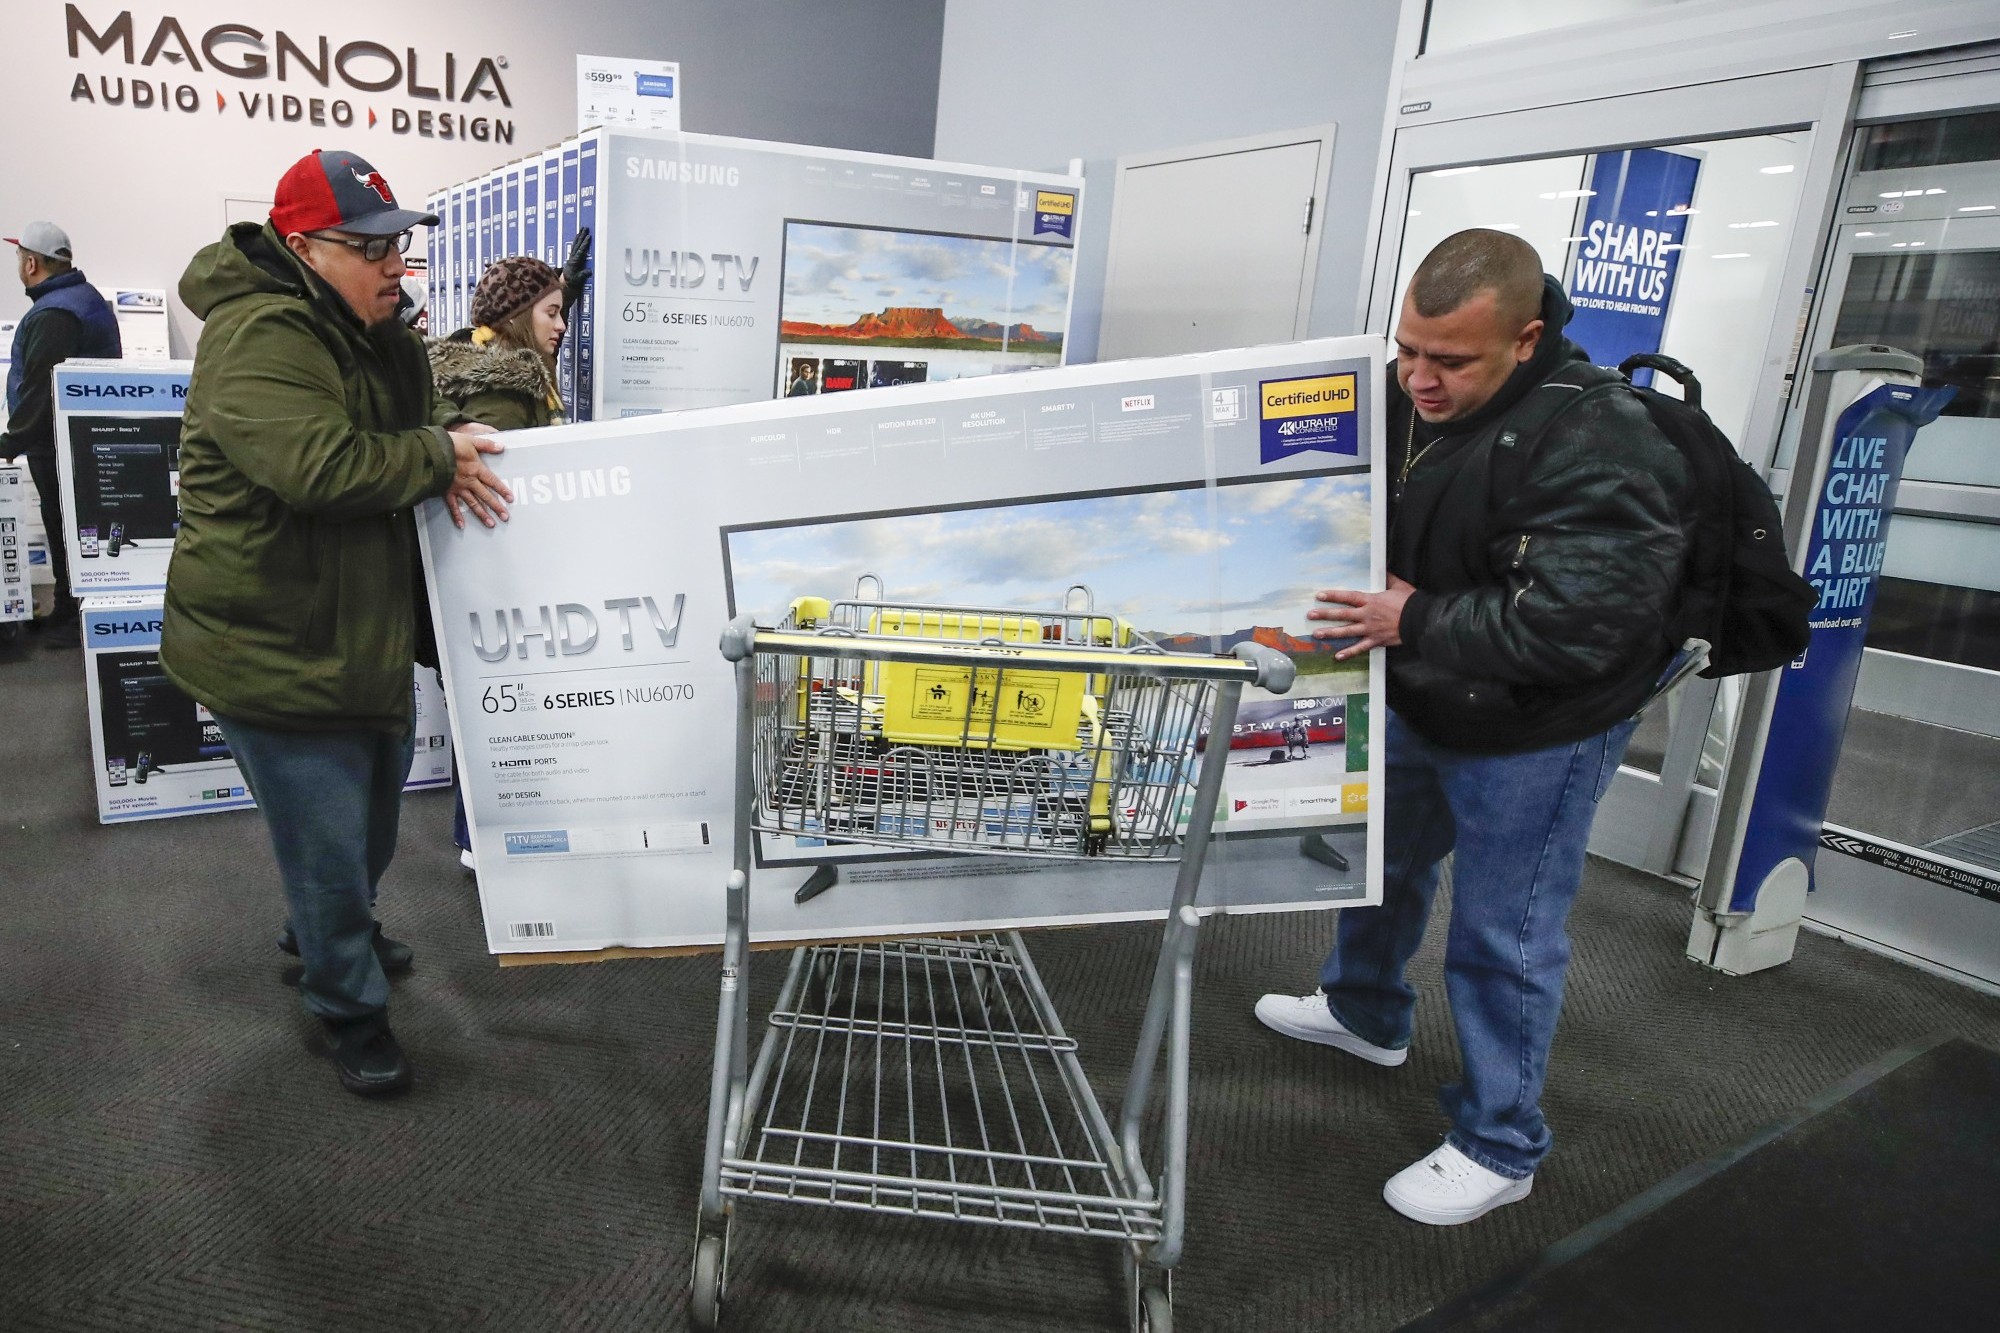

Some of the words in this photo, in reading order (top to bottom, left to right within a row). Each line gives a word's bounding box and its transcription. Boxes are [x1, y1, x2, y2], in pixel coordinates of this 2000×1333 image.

[65, 3, 512, 107] MAGNOLIA
[71, 73, 200, 113] AUDIO
[239, 91, 353, 127] VIDEO
[392, 108, 514, 144] DESIGN
[626, 156, 740, 187] SAMSUNG
[1584, 219, 1673, 269] SHARE
[625, 248, 706, 289] UHD
[711, 253, 760, 292] TV
[1576, 259, 1637, 298] WITH
[1638, 268, 1668, 302] US
[1571, 296, 1589, 307] WE'D
[1589, 297, 1605, 310] LOVE
[1605, 299, 1615, 311] TO
[1614, 301, 1631, 313] HEAR
[1631, 303, 1648, 314] FROM
[1648, 306, 1661, 316] YOU
[714, 315, 755, 328] NU6070
[65, 384, 155, 398] SHARP
[1215, 392, 1224, 404] 4
[1266, 391, 1321, 407] Certified
[1322, 388, 1350, 402] UHD
[1041, 404, 1065, 413] SMART
[1065, 402, 1075, 411] TV
[1124, 398, 1151, 408] NETFLIX
[826, 427, 842, 436] HDR
[878, 421, 906, 430] MOTION
[906, 419, 925, 427] RATE
[924, 417, 936, 425] 120
[962, 418, 1006, 429] RESOLUTION
[1278, 421, 1295, 435] 4K
[1295, 418, 1323, 429] ULTRA
[1324, 417, 1338, 427] HD
[1295, 426, 1338, 434] CONNECTED
[1832, 437, 1887, 469] LIVE
[498, 465, 632, 505] MSUNG
[1826, 473, 1890, 505] CHAT
[1822, 508, 1882, 540] WITH
[1810, 545, 1832, 575] A
[1840, 541, 1885, 574] BLUE
[94, 620, 163, 635] SHAR
[469, 602, 599, 663] UHD
[604, 593, 686, 651] TV
[1808, 617, 1841, 629] wnload
[1841, 618, 1851, 627] our
[626, 683, 695, 705] NU6070
[1293, 699, 1317, 709] HBO
[1316, 697, 1343, 707] NOW
[1199, 716, 1344, 735] WSTWORLD
[489, 736, 513, 744] CLEAN
[513, 734, 536, 742] CABLE
[509, 743, 536, 751] manages
[565, 740, 580, 750] crisp
[580, 739, 596, 747] clean
[499, 759, 532, 767] HDMI
[534, 757, 558, 766] PORTS
[507, 770, 522, 778] cable
[531, 769, 545, 777] both
[546, 768, 562, 776] audio
[514, 791, 541, 799] DESIGN
[516, 799, 534, 808] stylish
[656, 791, 675, 800] sitting
[1299, 797, 1338, 806] SmartThings
[1866, 845, 1901, 861] CAUTION:
[1904, 856, 1949, 876] AUTOMATIC
[1950, 870, 1983, 887] SLIDING
[1883, 858, 1898, 868] Door
[1899, 863, 1912, 872] may
[1913, 867, 1928, 877] close
[1929, 873, 1953, 885] without
